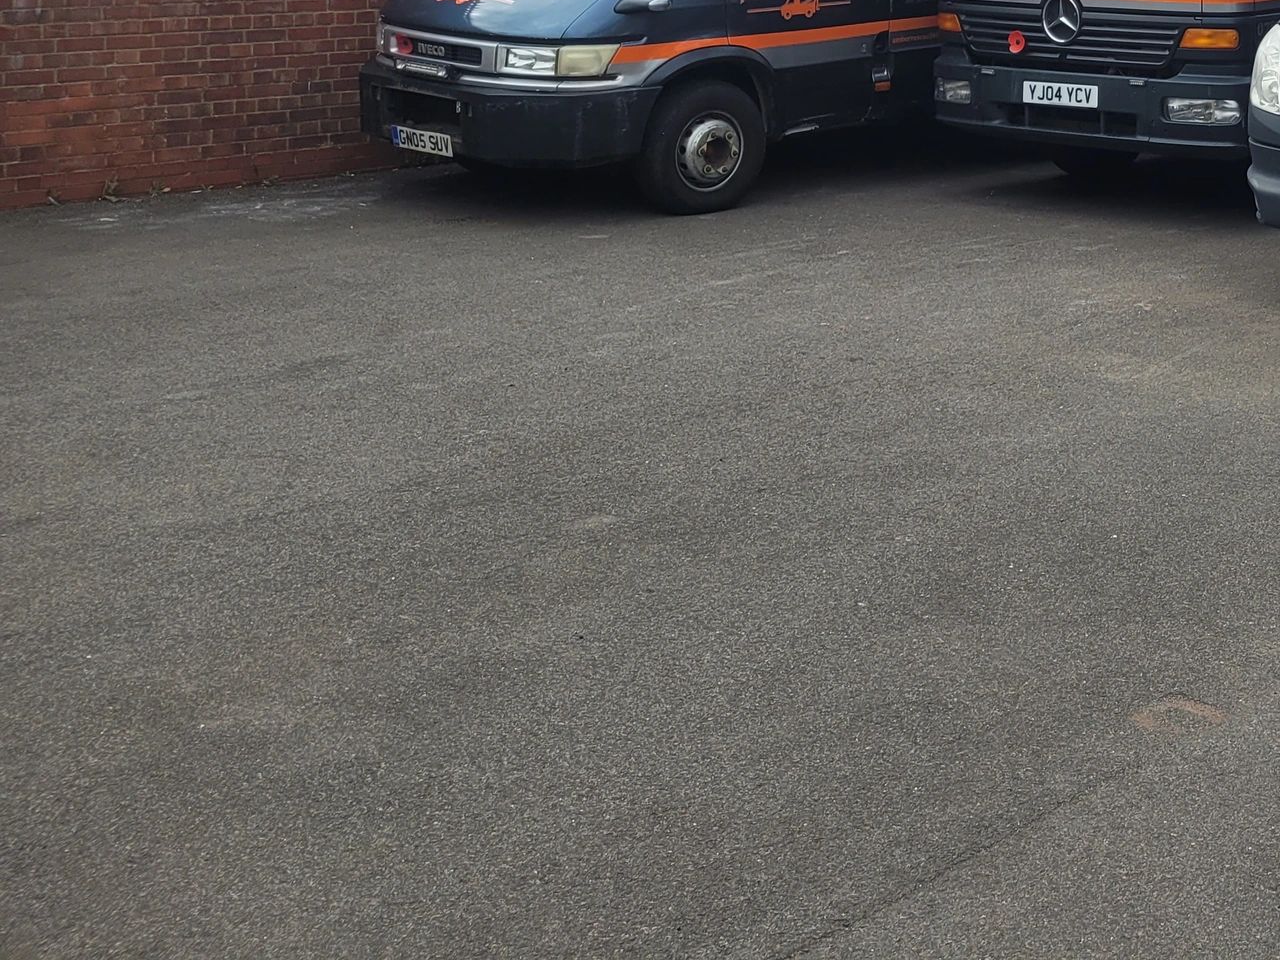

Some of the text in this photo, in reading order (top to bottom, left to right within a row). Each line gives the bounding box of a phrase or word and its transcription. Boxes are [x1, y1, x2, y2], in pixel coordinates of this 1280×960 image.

[418, 42, 445, 56] IVECO
[1029, 84, 1092, 105] YJ04 YCV
[399, 129, 449, 153] GN05 SUV
